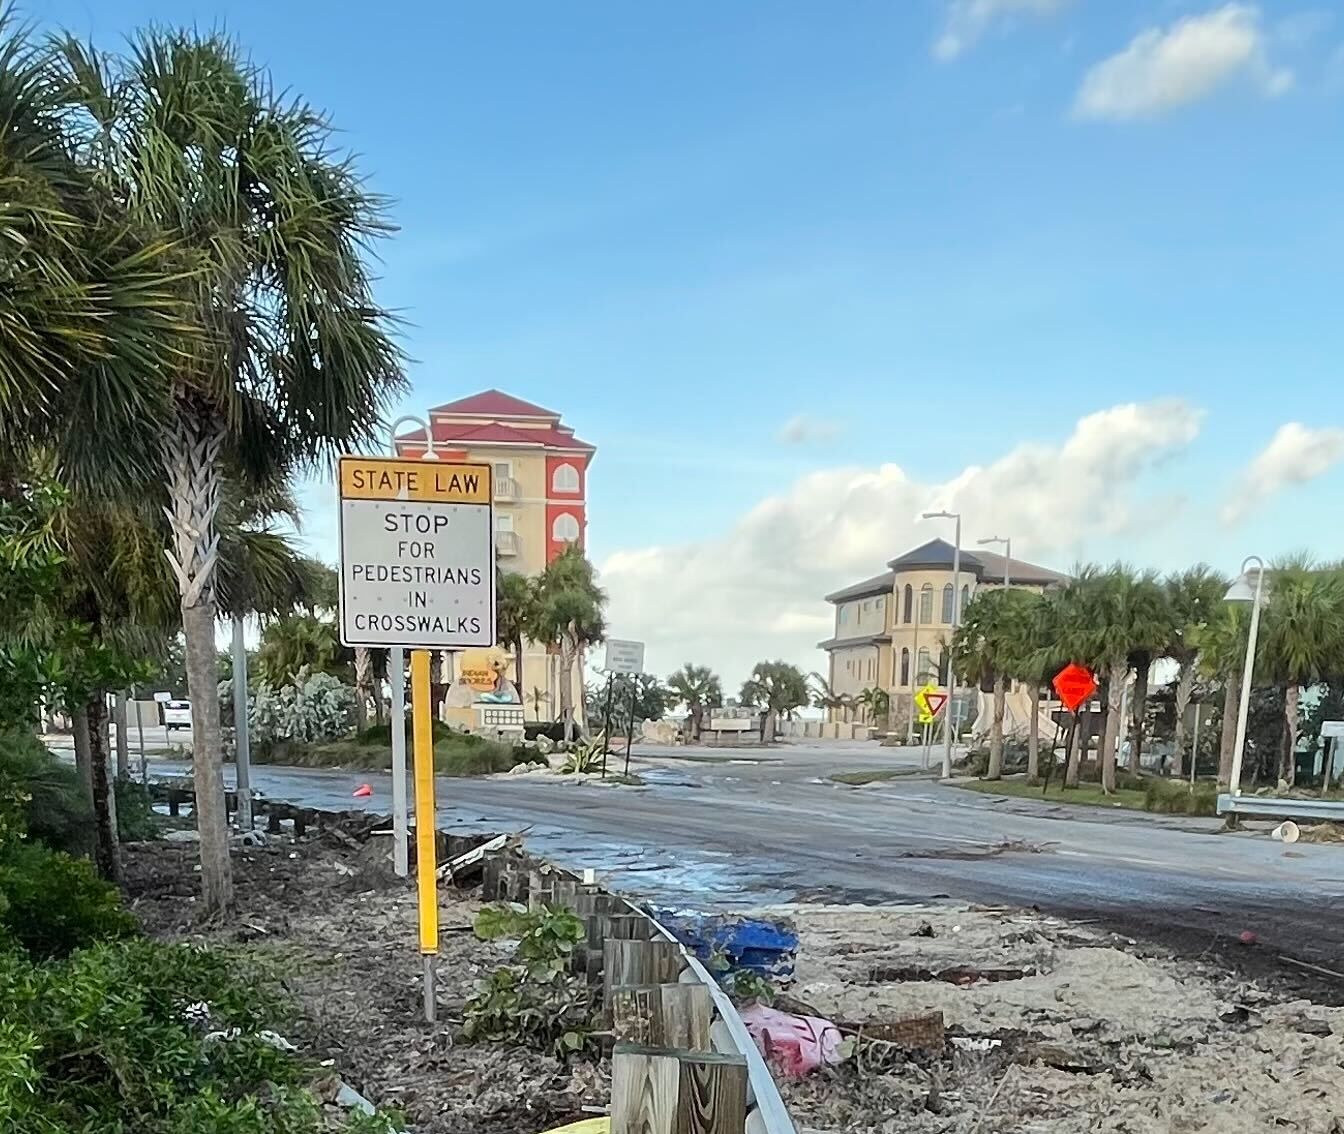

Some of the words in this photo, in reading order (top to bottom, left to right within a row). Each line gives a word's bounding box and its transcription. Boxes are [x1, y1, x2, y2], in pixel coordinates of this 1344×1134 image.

[352, 470, 419, 491] STATE
[435, 473, 479, 493] LAW
[384, 513, 449, 534] STOP
[398, 541, 435, 559] FOR
[352, 565, 481, 585] PEDESTRIANS
[408, 591, 426, 608] IN
[355, 614, 481, 634] CROSSWALKS
